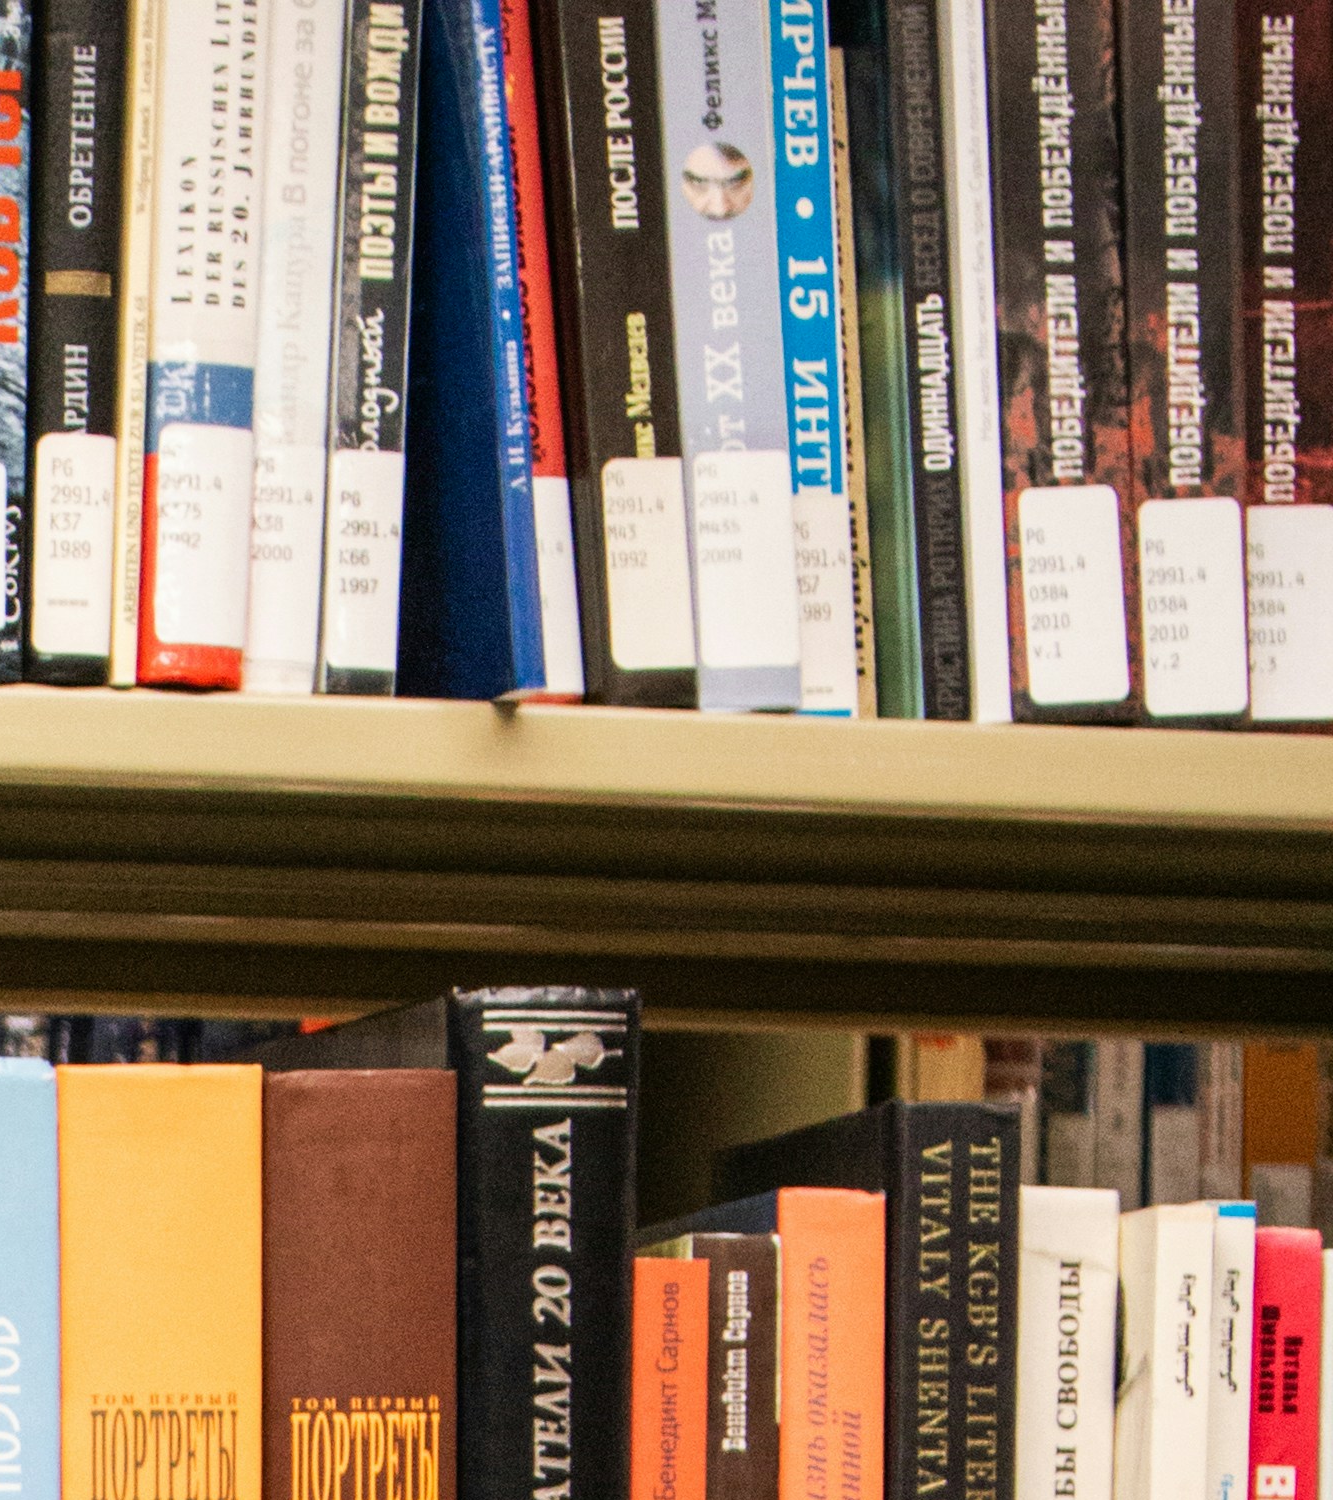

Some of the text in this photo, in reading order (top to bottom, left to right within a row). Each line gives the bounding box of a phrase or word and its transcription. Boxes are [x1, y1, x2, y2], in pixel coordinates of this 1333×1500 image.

[70, 45, 98, 229] ОБРЕТЕНИЕ
[359, 2, 409, 281] ПОЭТЫ ВОЖДИ
[597, 16, 641, 230] ПОСЛЕ РОССИИ
[704, 228, 739, 331] века
[788, 253, 831, 322] 15
[1255, 14, 1299, 502] ПОБЕДИТЕЛИ ПОБЕЖДЁННЫЕ
[915, 292, 951, 473] ОДИННАДЦАТЬ
[1045, 272, 1087, 479] ПОБЕДИТЕЛИ
[1165, 281, 1207, 488] ПОБЕДИТЕЛИ
[533, 1118, 573, 1250] ВЕКА
[918, 1141, 954, 1301] VITALY
[967, 1138, 1002, 1227] THE
[533, 1264, 573, 1326] 20
[654, 1280, 682, 1358] Сарнов
[807, 1255, 833, 1429] оказалась
[968, 1241, 1001, 1368] KGB'S
[1054, 1261, 1083, 1431] СВОБОДЫ
[292, 1394, 440, 1411] ТОМ ПЕРВЫЙ
